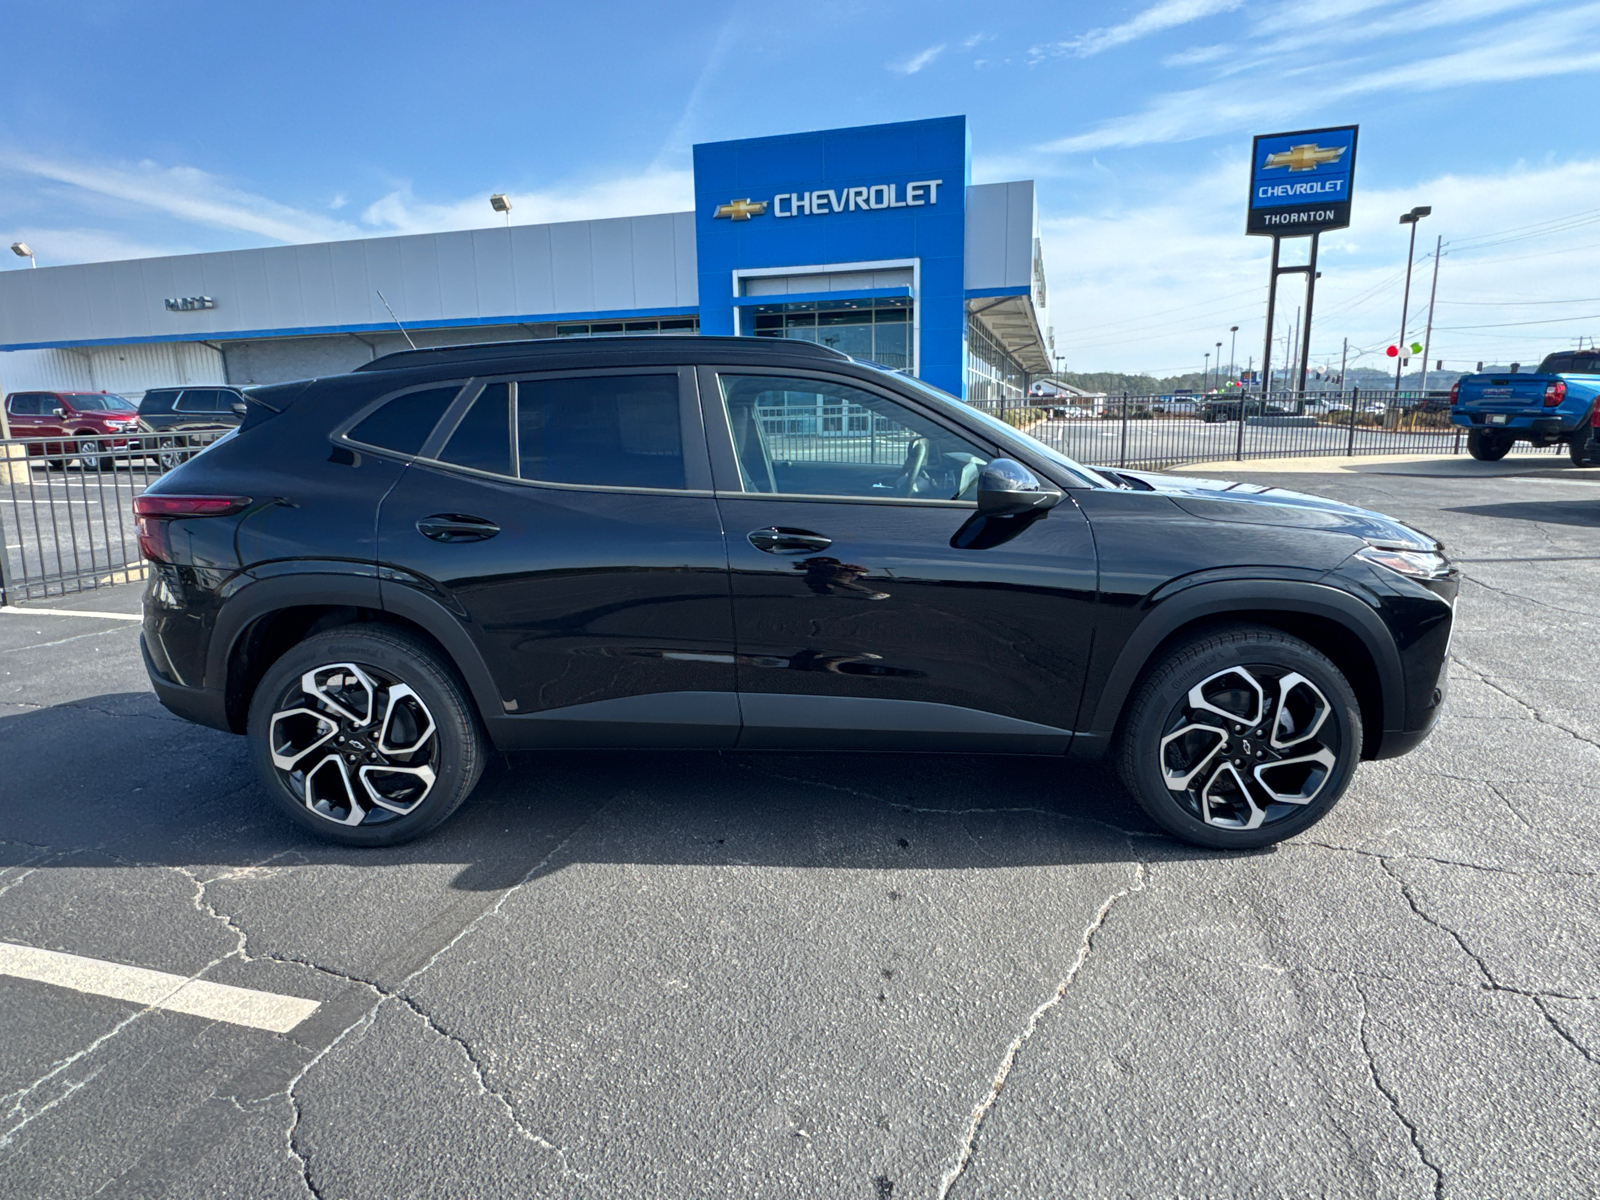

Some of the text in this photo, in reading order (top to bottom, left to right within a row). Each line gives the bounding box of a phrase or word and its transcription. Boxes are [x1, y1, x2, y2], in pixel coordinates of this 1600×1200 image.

[774, 179, 943, 218] CHEVROLET
[1258, 179, 1344, 198] CHEVROLET
[1264, 210, 1335, 225] THORNTON
[1172, 655, 1217, 690] Continental
